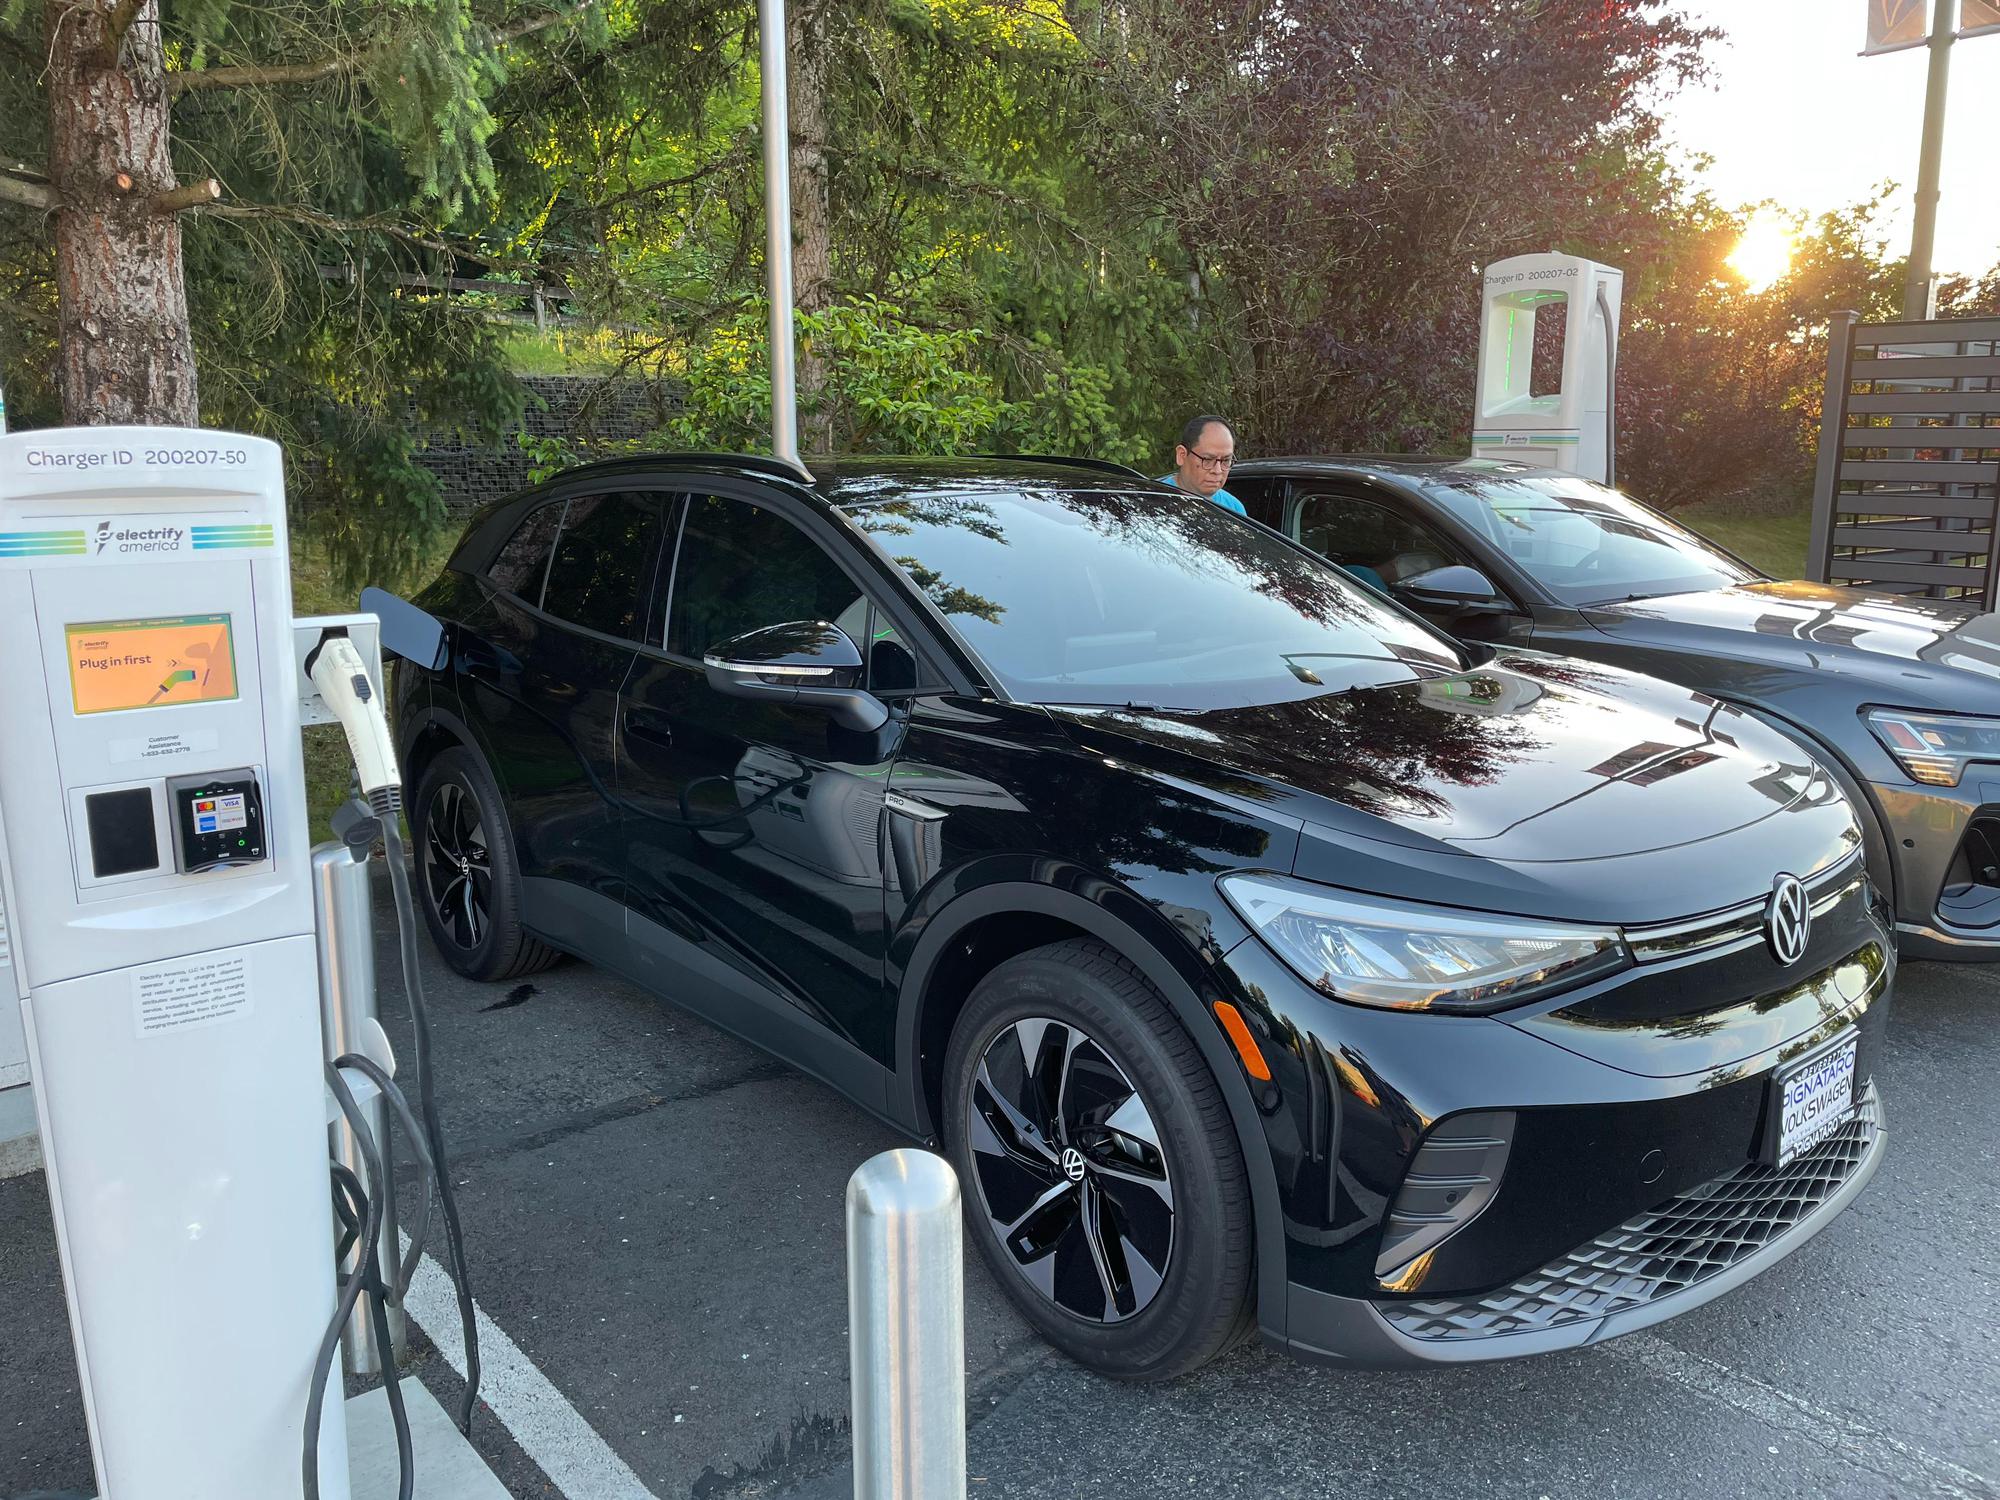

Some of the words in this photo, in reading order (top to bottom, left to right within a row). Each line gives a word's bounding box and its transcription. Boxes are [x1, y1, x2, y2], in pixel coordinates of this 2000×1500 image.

[1484, 274, 1514, 285] Charger
[1515, 273, 1525, 282] ID
[1528, 268, 1578, 281] 200207-02
[27, 450, 108, 469] Charger
[113, 450, 133, 465] ID
[145, 449, 247, 466] 200207-50
[116, 526, 184, 543] electrify
[119, 540, 180, 553] america
[80, 658, 108, 670] Plug
[110, 656, 122, 666] in
[124, 655, 152, 665] first
[224, 800, 240, 808] VISA
[889, 796, 904, 806] PRO
[1808, 1049, 1841, 1077] EVERETT
[1783, 1051, 1854, 1108] PIGNATARO
[1781, 1072, 1853, 1138] VOLKSWAGEN
